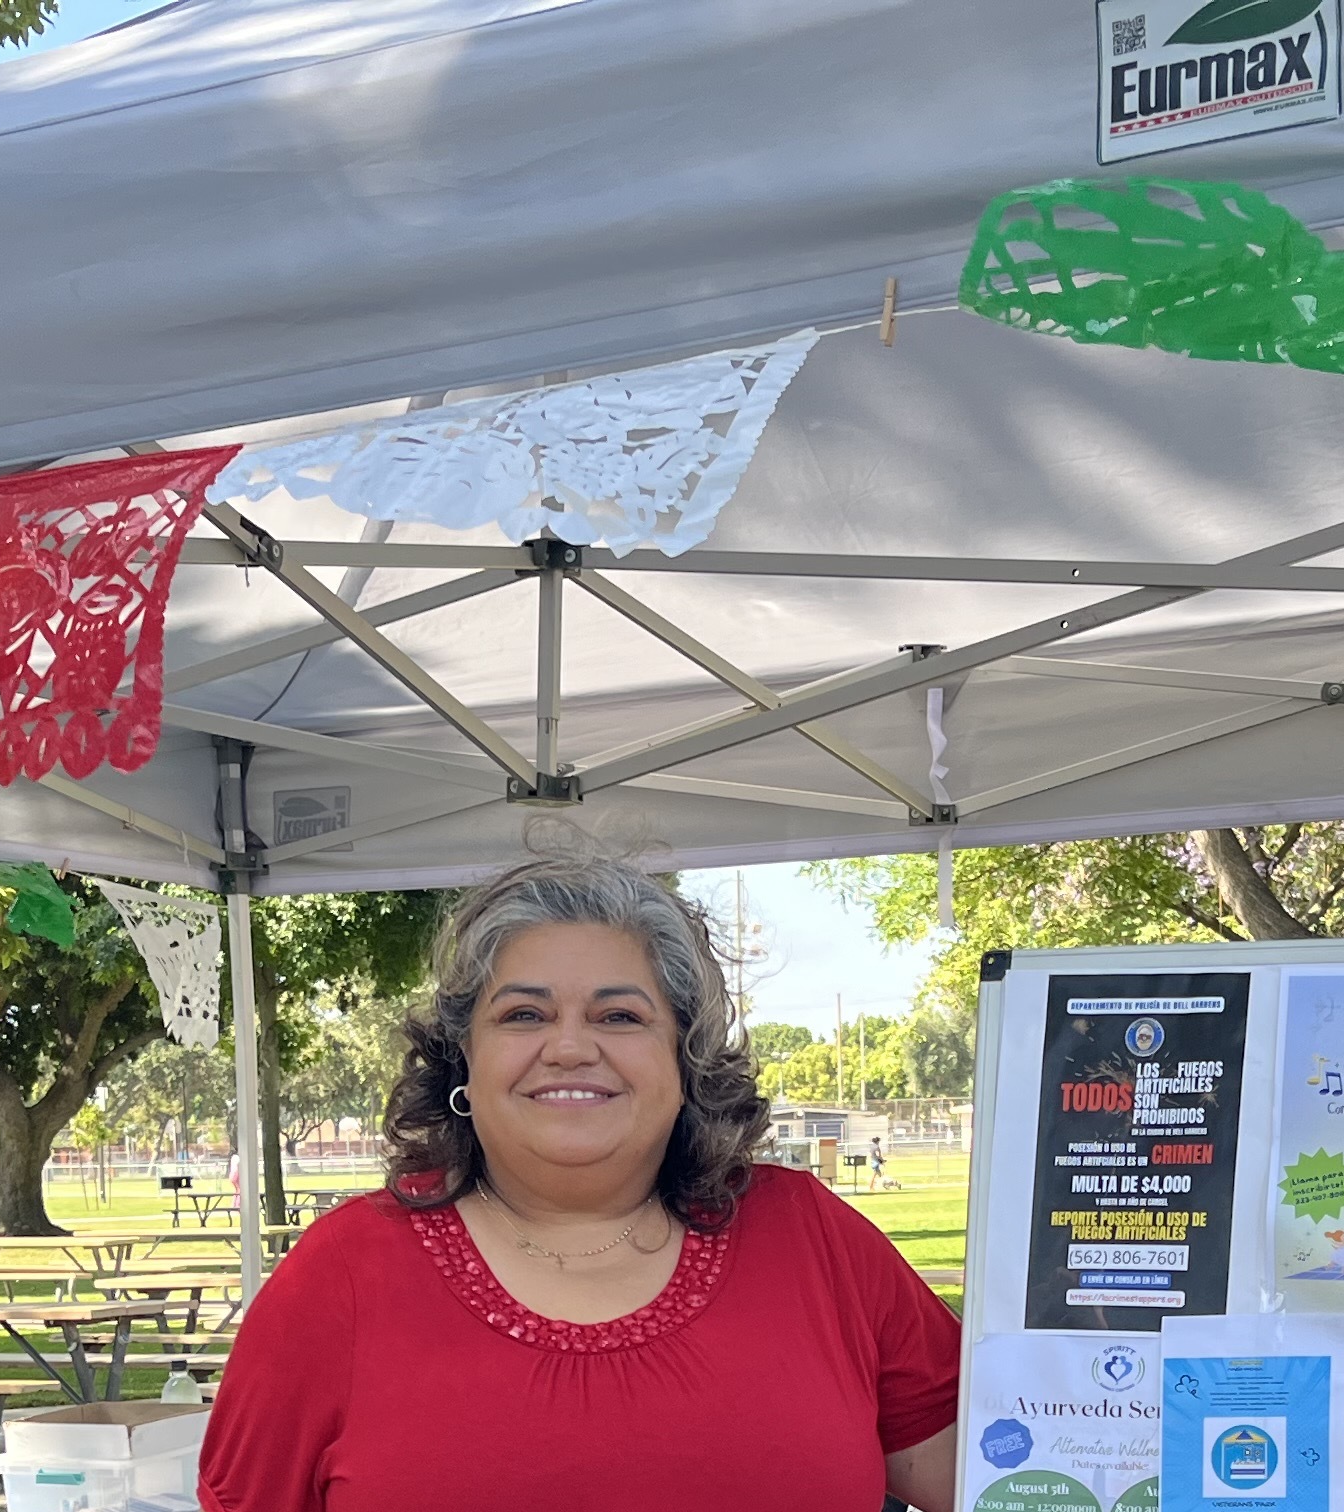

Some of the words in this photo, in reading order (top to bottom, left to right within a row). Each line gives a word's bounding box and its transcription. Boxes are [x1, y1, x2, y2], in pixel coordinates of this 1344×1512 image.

[1111, 32, 1313, 122] Eurmax
[1189, 98, 1245, 118] EURMAX
[1247, 82, 1313, 103] OUTDOOR
[1136, 1063, 1160, 1077] LOS
[1178, 1061, 1223, 1077] FUEGOS
[1135, 1078, 1213, 1094] ARTIFICIALES
[1061, 1082, 1133, 1112] TODOS
[1134, 1094, 1159, 1109] SON
[1132, 1108, 1205, 1125] PROHIBIDOS
[1152, 1144, 1214, 1164] CRIMEN
[1071, 1175, 1118, 1193] MULTA
[1121, 1176, 1138, 1192] DE
[1141, 1175, 1192, 1194] $4,000
[1051, 1211, 1098, 1226] REPORTE
[1100, 1209, 1153, 1226] POSESIÓN
[1156, 1212, 1165, 1226] O
[1167, 1212, 1189, 1226] USO
[1192, 1212, 1207, 1227] DE
[1072, 1226, 1113, 1240] FUEGOS
[1114, 1226, 1187, 1240] ARTIFICIALES
[1069, 1250, 1108, 1267] (562)
[1112, 1250, 1185, 1266] 806-7601
[1010, 1396, 1122, 1420] Ayurveda
[986, 1431, 1025, 1458] FREE
[1006, 1481, 1048, 1496] August
[1051, 1483, 1070, 1496] 5th
[977, 1498, 1003, 1510] 8:00
[1006, 1501, 1025, 1511] am
